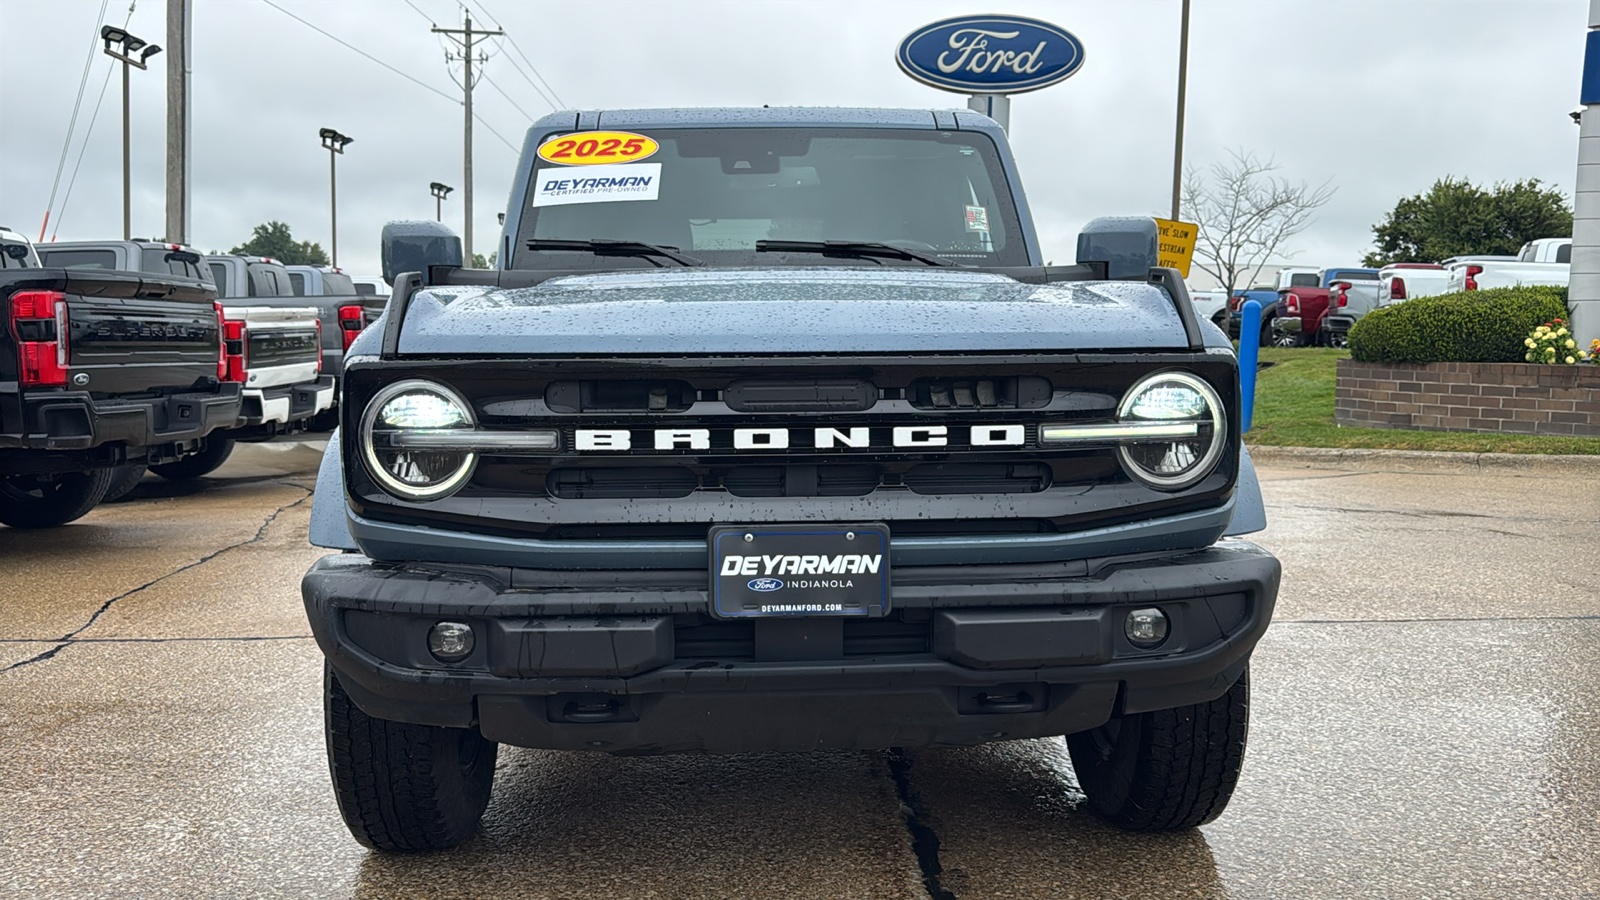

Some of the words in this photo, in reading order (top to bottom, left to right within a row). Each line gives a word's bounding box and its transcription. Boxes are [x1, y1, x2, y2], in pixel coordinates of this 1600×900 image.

[937, 28, 1047, 74] Ford
[550, 138, 646, 159] 2025
[543, 176, 652, 192] DEYARMAN
[550, 188, 595, 196] CERTIFIED
[597, 186, 648, 194] PRE-OWNED
[1158, 226, 1170, 237] IVE
[1172, 228, 1190, 240] SLOW
[1159, 243, 1186, 255] ESTRIAN
[1158, 259, 1177, 268] AFFIC
[575, 424, 1025, 451] BRONCO
[720, 554, 882, 576] DEYARMAN
[754, 579, 776, 589] Ford
[787, 580, 853, 588] INDIANOLA
[761, 603, 842, 612] DEYARMANFORD.COM
